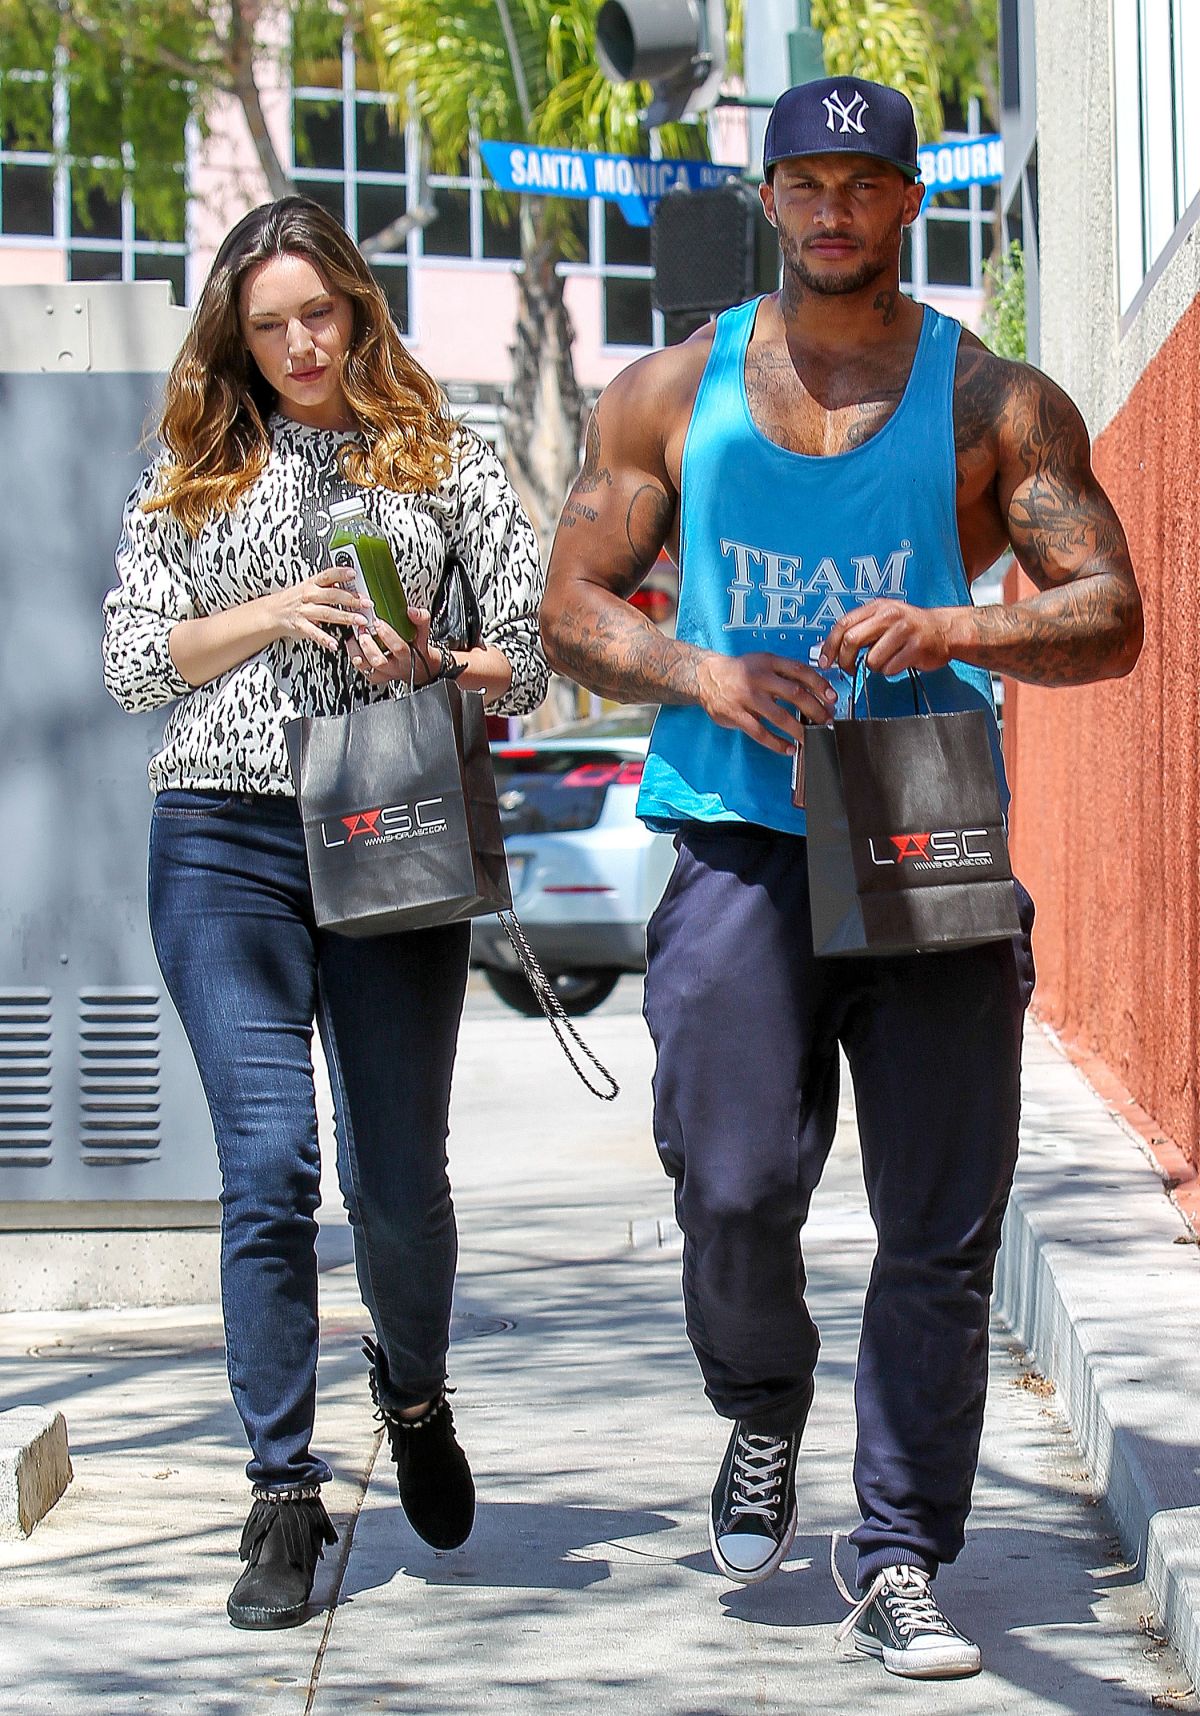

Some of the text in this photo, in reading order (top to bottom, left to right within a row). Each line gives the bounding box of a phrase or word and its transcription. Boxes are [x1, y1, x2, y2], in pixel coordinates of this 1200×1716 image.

[511, 150, 587, 192] SANTA
[594, 159, 691, 196] MONICA
[720, 538, 914, 595] TEAM
[722, 586, 907, 632] LEA
[321, 797, 446, 848] LASC
[868, 829, 992, 865] LASC
